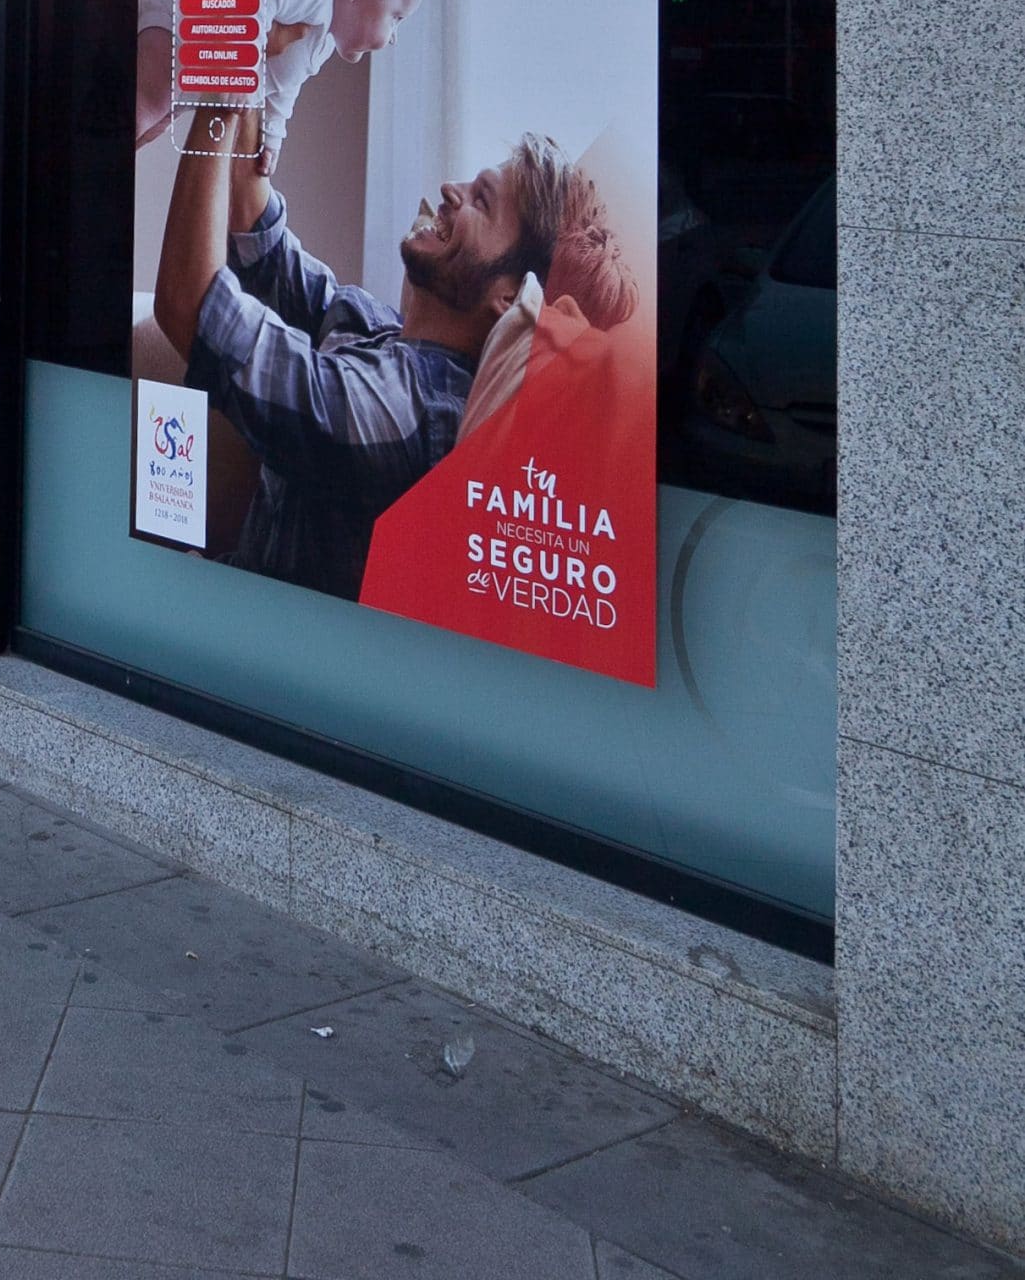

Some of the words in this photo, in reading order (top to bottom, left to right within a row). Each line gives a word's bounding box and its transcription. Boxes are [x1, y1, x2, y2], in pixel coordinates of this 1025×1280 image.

[201, 0, 236, 9] BUSCADOR
[191, 24, 248, 35] AUTORIZACIONES
[198, 50, 213, 60] CITA
[214, 50, 239, 61] ONLINE
[181, 75, 219, 85] REEMBOLSO
[220, 76, 229, 86] DE
[229, 76, 256, 87] GASTOS
[149, 460, 166, 476] 800
[521, 457, 557, 498] tu
[466, 480, 616, 540] FAMILIA
[496, 520, 565, 549] NECESITA
[568, 537, 590, 556] UN
[467, 534, 617, 594] SEGURO
[491, 572, 617, 630] VERDAD
